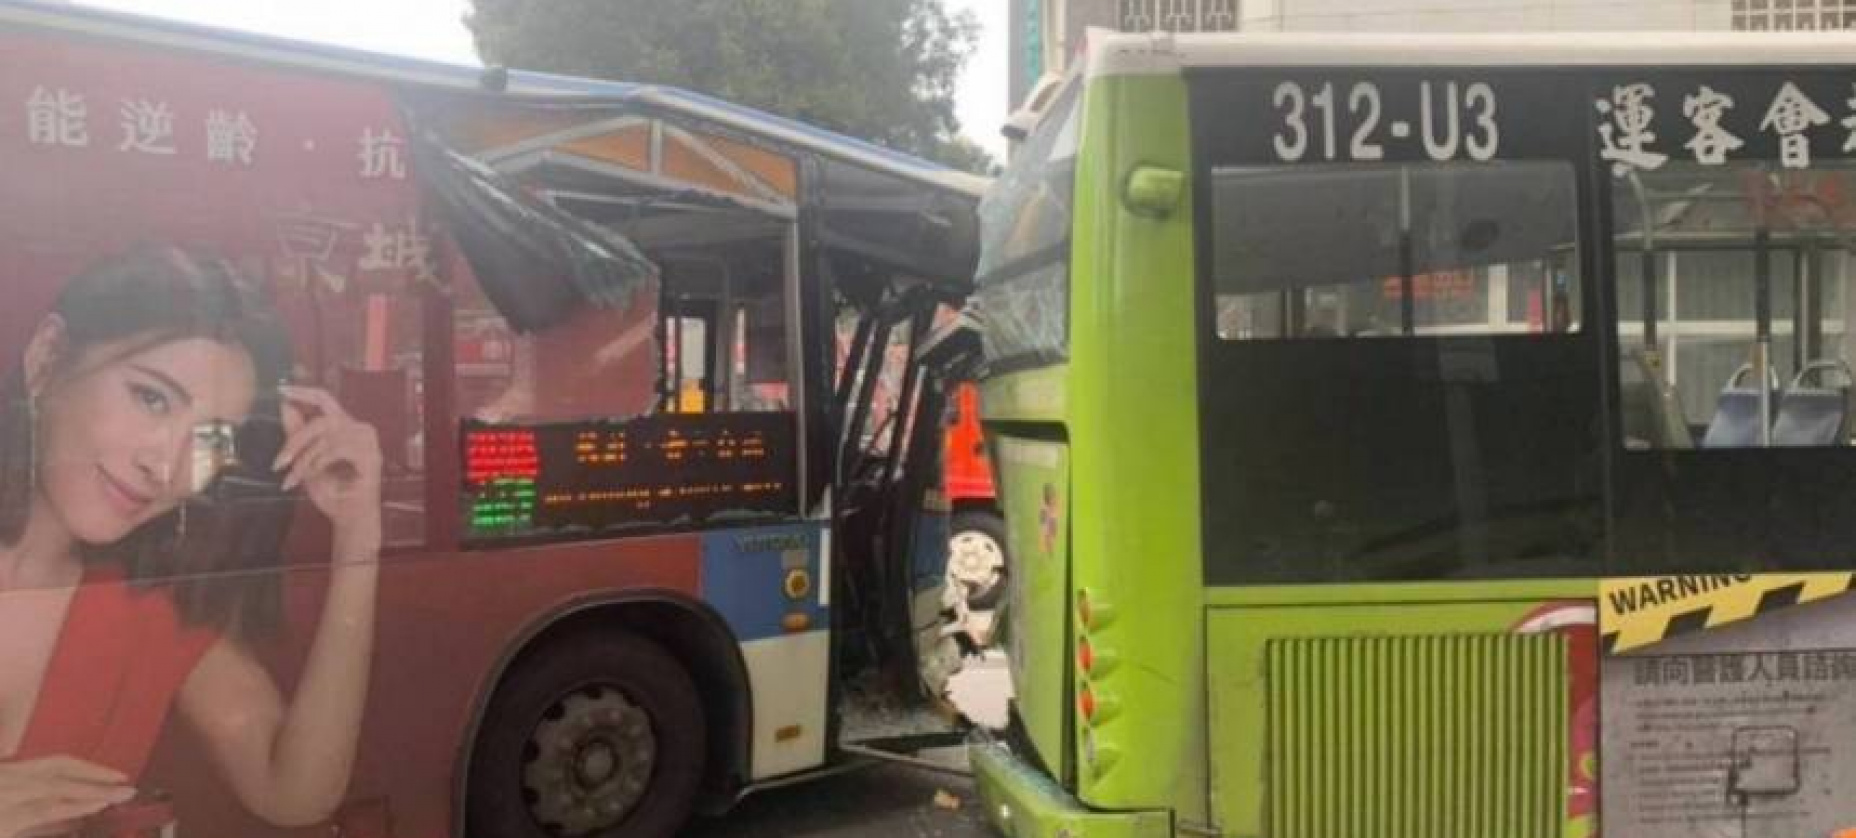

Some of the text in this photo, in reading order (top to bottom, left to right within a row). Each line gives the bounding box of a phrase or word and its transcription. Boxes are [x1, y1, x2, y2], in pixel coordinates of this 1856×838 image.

[1273, 81, 1498, 161] 312-U3
[1595, 81, 1856, 177] 運客會
